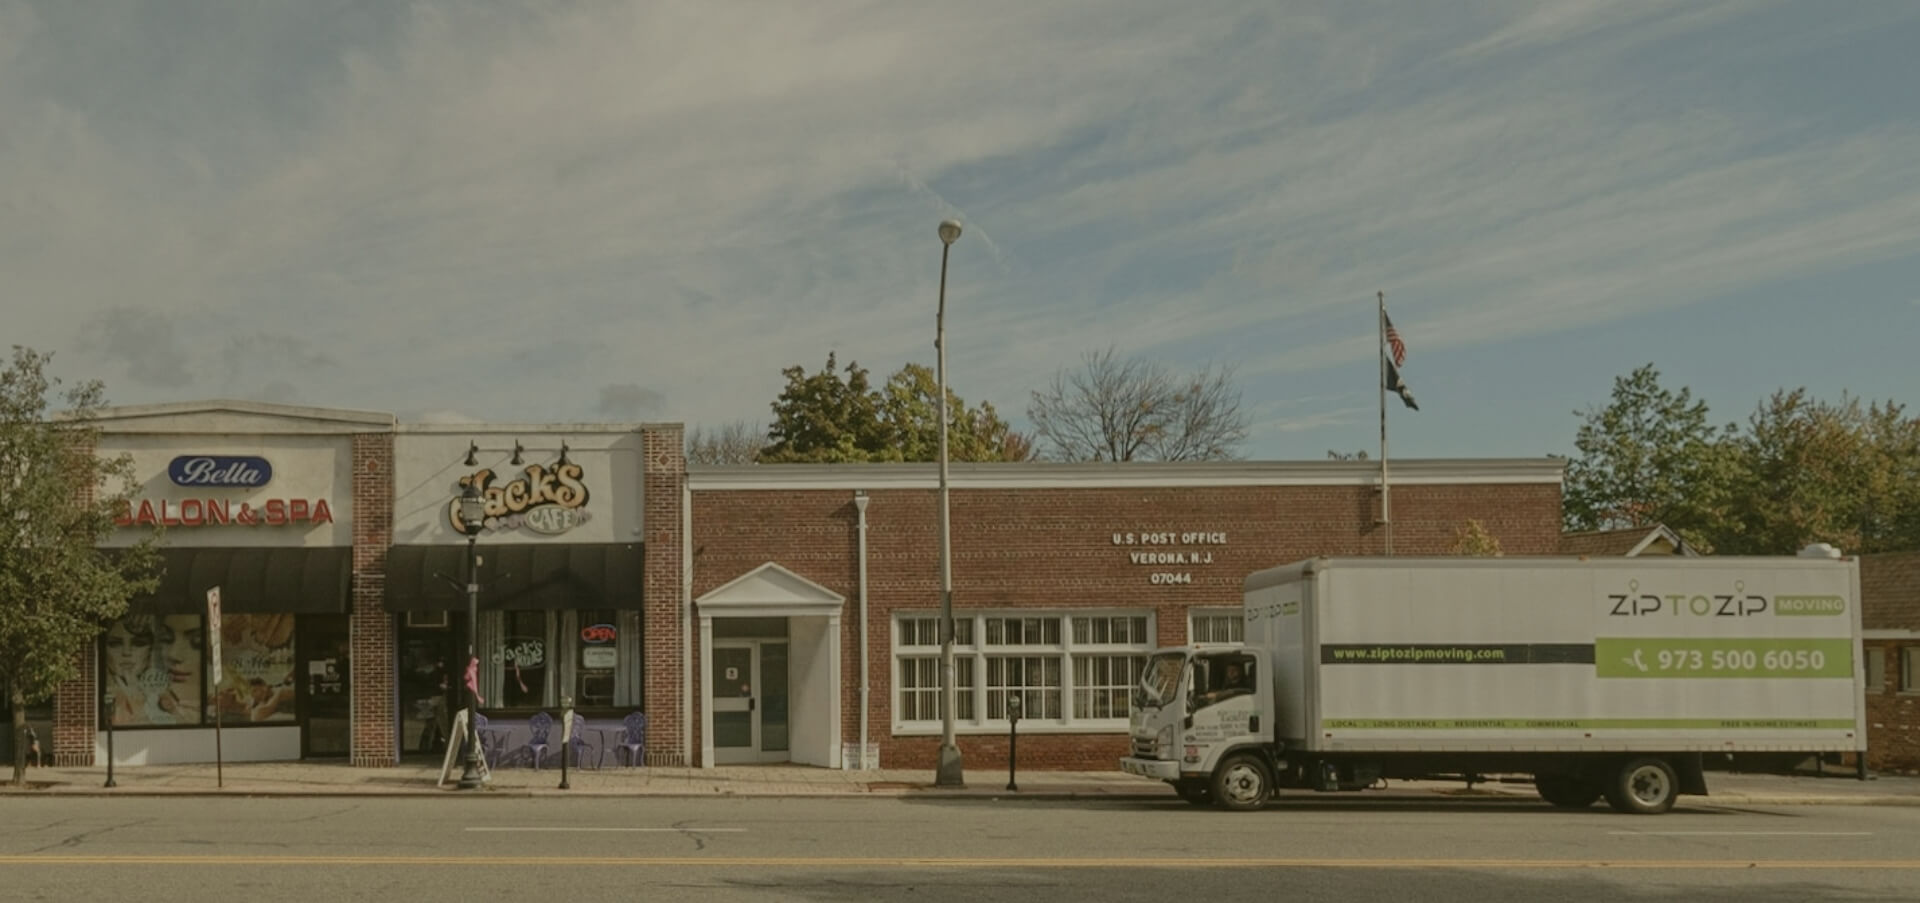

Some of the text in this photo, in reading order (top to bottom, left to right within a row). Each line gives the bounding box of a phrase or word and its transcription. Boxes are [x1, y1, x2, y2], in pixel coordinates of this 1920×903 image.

[177, 457, 263, 484] Bella
[236, 501, 258, 525] &
[264, 498, 333, 525] SPA
[1113, 532, 1226, 545] U.S. POST OFFICE
[1151, 572, 1191, 584] 07044
[1779, 599, 1844, 611] MOVING
[581, 627, 616, 641] OPEN
[1334, 647, 1505, 661] www.ziptozipmoving.com
[1658, 650, 1825, 670] 973 500 6050
[1331, 719, 1579, 729] LOCAL LONG DISTANCE RESIDENTIAL COMMERCIAL
